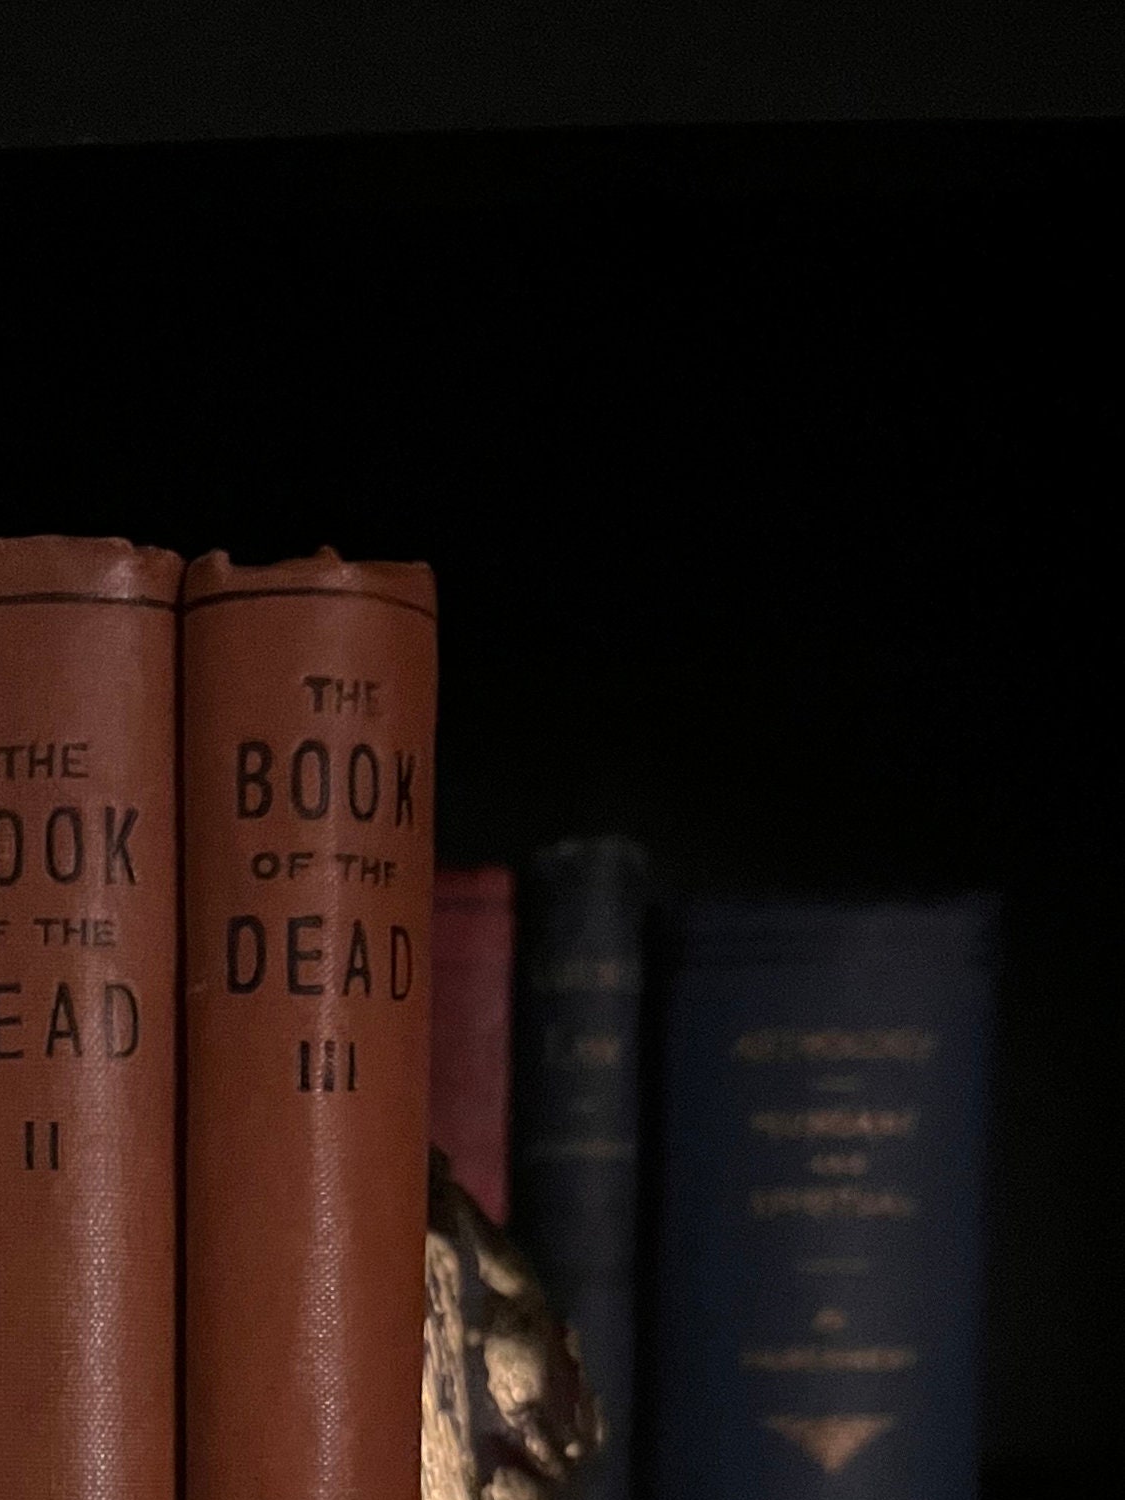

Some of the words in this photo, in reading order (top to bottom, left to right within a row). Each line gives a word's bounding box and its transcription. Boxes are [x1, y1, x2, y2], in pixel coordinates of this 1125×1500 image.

[303, 674, 384, 718] THE
[236, 740, 416, 828] BOOK
[251, 851, 314, 881] OF
[336, 852, 398, 890] THE
[33, 917, 116, 948] THE
[226, 914, 414, 1002] DEAD
[297, 1040, 357, 1093] III
[24, 1121, 60, 1171] II
